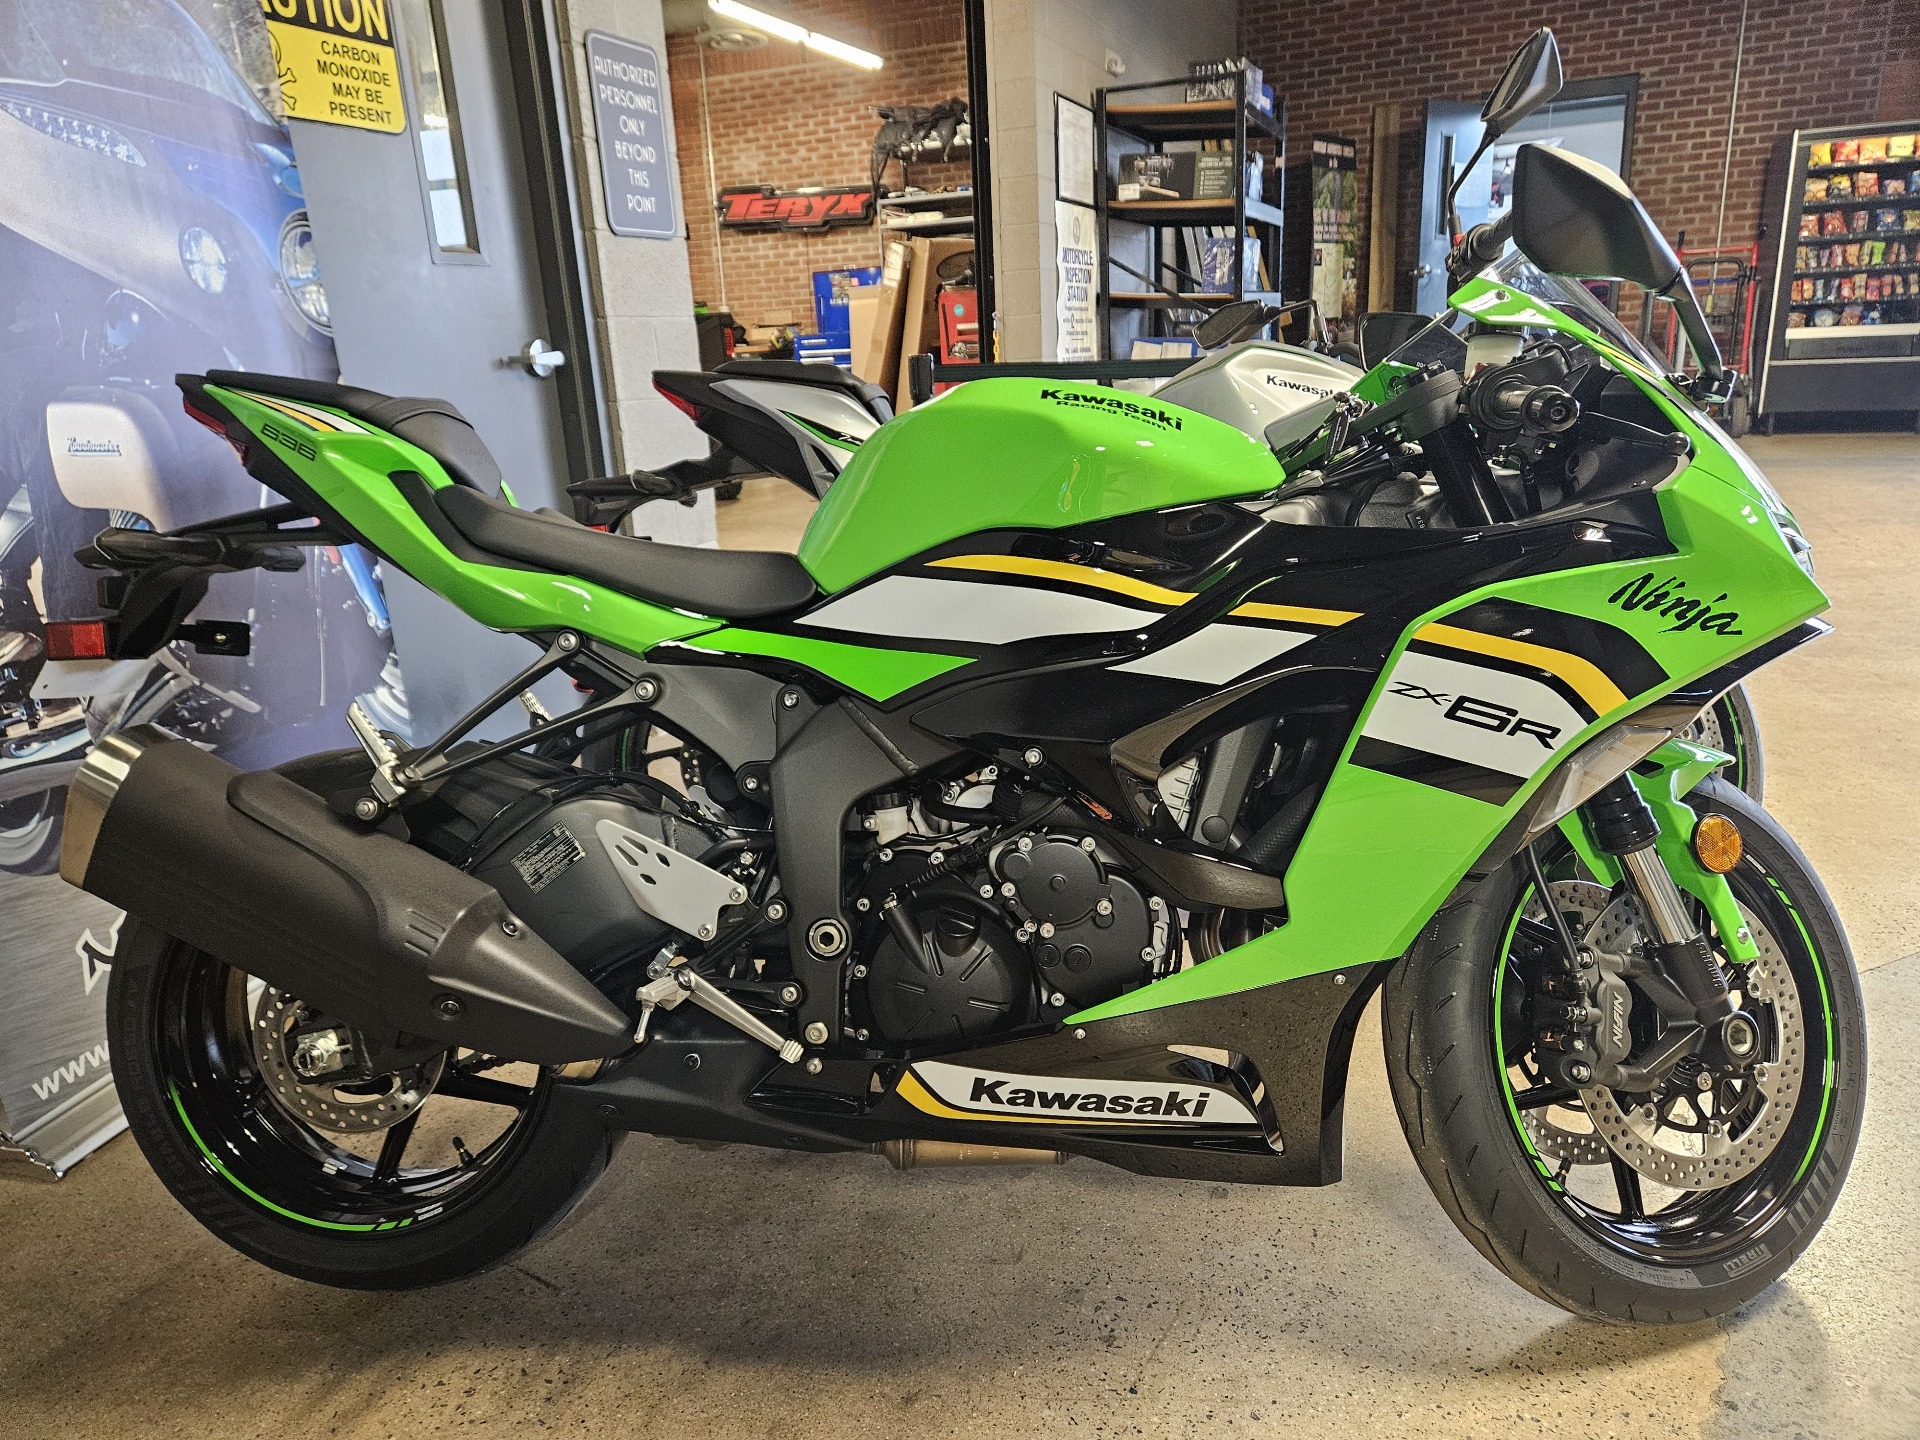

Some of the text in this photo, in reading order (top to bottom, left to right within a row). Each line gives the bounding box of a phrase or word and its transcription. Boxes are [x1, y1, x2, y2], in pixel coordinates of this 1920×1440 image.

[321, 40, 381, 66] CARBON
[317, 59, 391, 87] MONOXIDE
[593, 55, 657, 89] AUTHORIZED
[332, 82, 384, 105] MAY BE
[598, 83, 658, 115] PERSONNEL
[329, 101, 392, 125] PRESENT
[618, 115, 646, 137] ONLY
[614, 140, 657, 164] BEYOND
[627, 168, 650, 188] THIS
[626, 194, 656, 213] POINT
[722, 192, 872, 224] TERYX
[1067, 285, 1088, 302] STATION
[1266, 374, 1334, 399] Kawasa
[1040, 389, 1183, 432] Kawasaki
[1056, 400, 1167, 431] Racing Team
[261, 422, 317, 462] 636
[1608, 573, 1743, 636] Ninja
[1386, 681, 1562, 751] ZX-6R
[969, 1076, 1210, 1118] Kawasaki
[1722, 1242, 1773, 1279] PIRELLI
